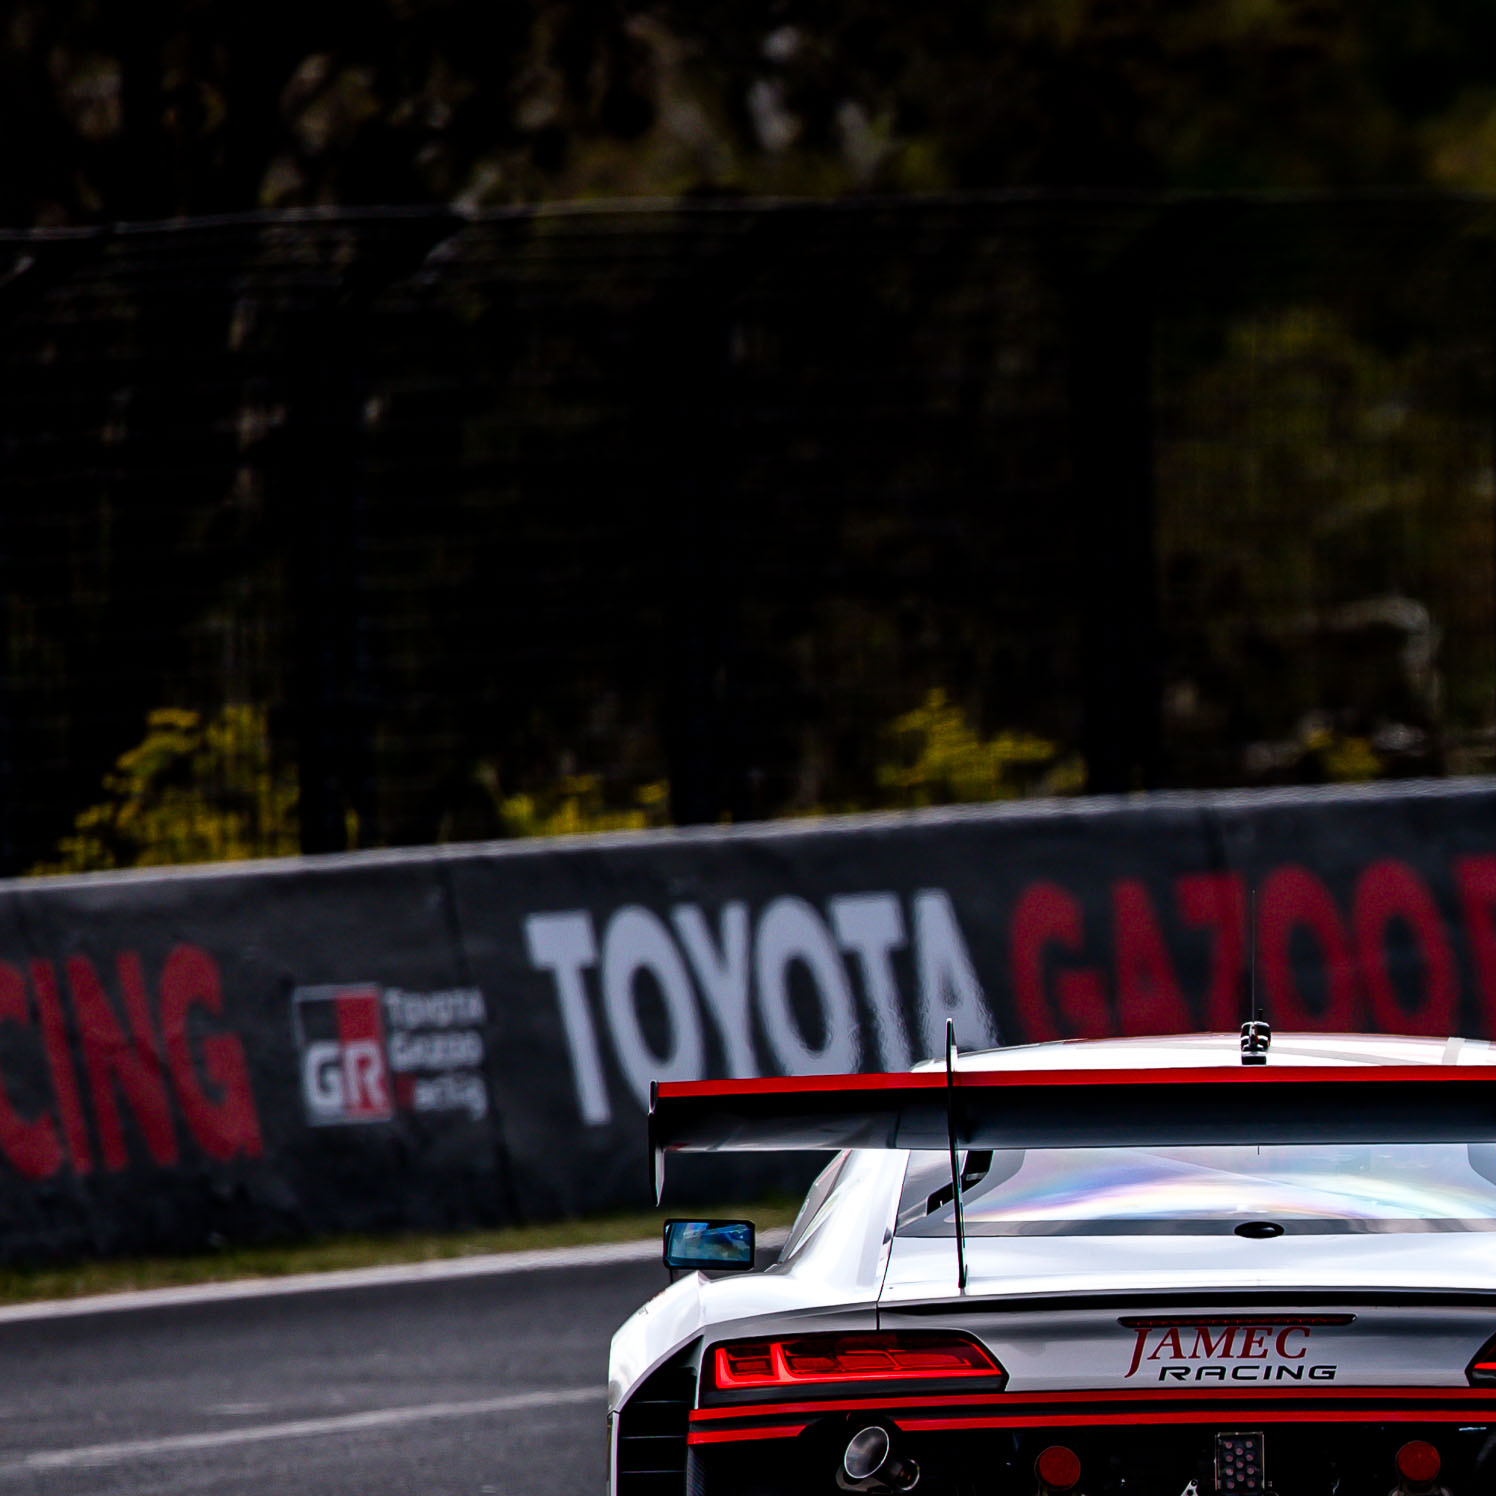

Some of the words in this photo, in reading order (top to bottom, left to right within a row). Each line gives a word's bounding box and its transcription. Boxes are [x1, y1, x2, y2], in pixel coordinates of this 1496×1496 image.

[524, 887, 1000, 1126] TOYOTA
[1124, 1326, 1311, 1379] JAMEC
[1158, 1365, 1338, 1381] RACING
